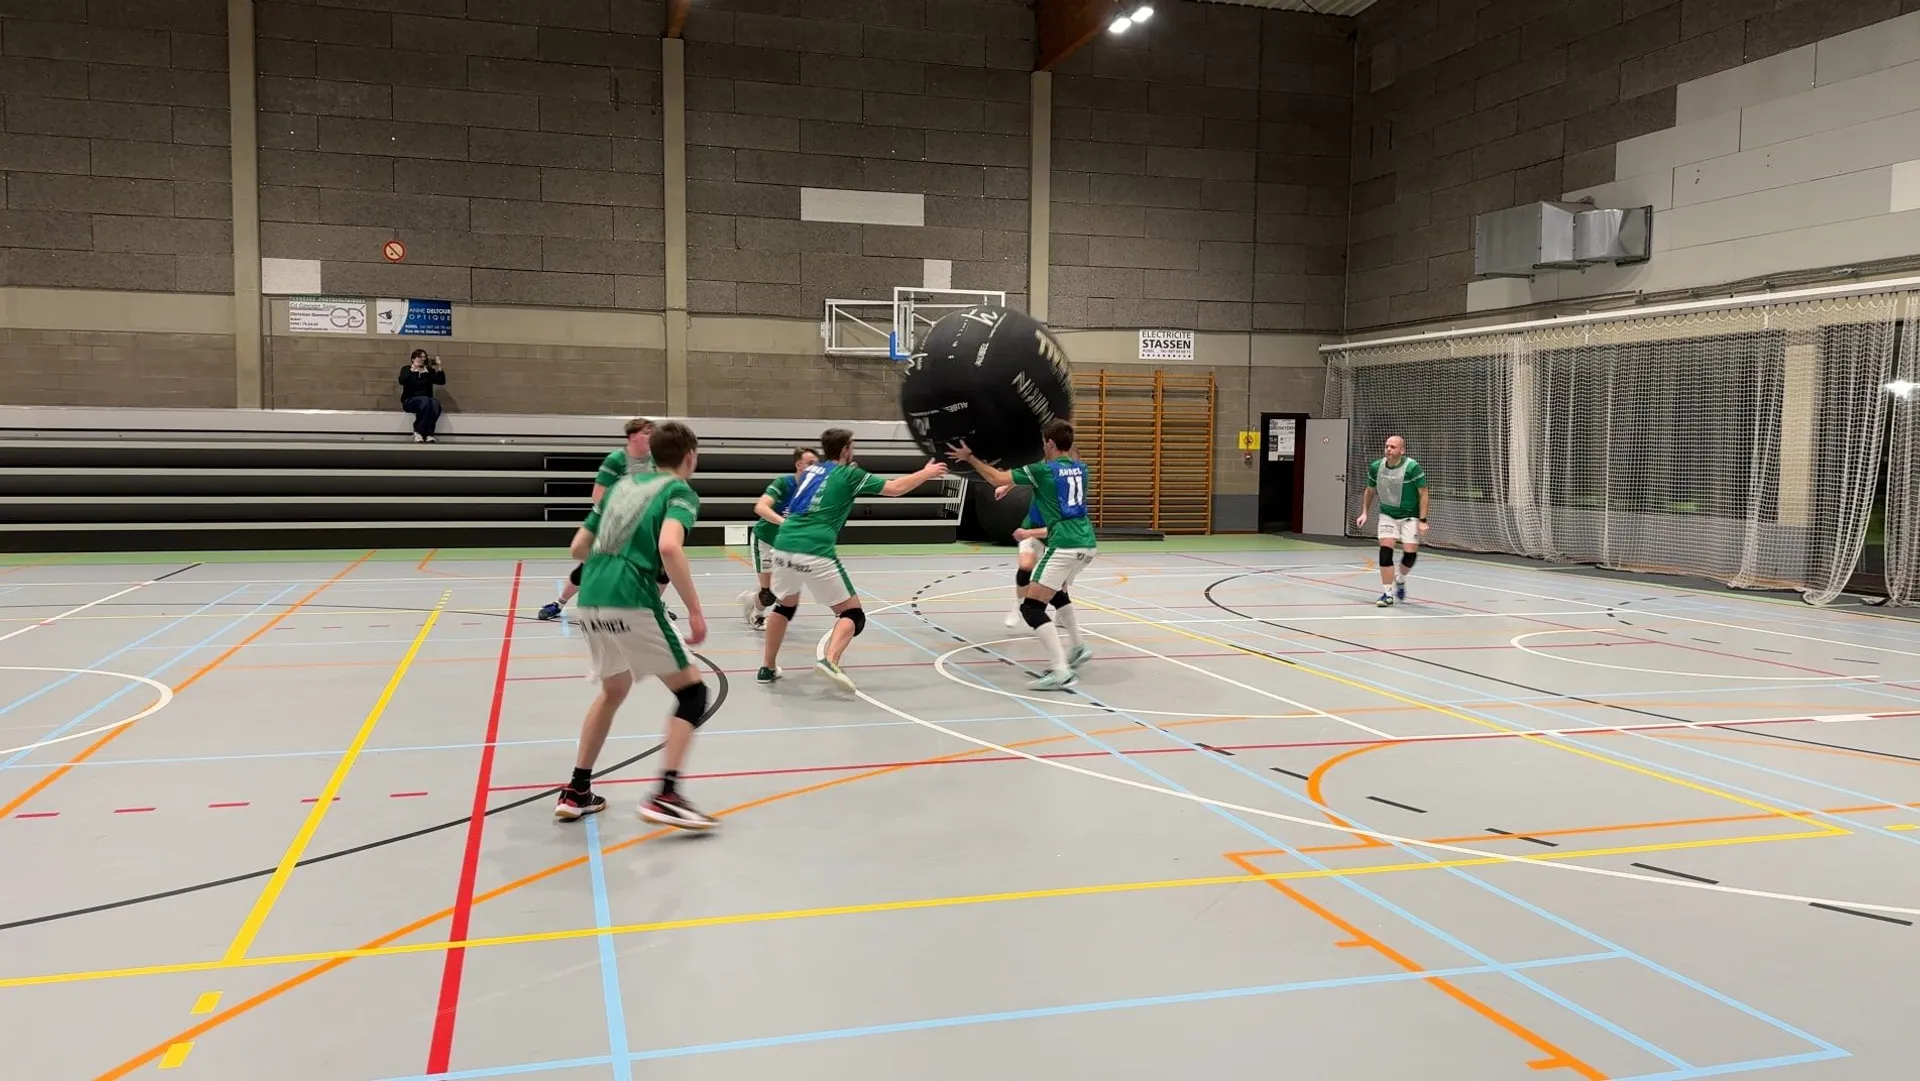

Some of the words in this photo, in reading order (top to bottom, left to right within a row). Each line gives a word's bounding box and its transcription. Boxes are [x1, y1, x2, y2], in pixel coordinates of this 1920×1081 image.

[1142, 330, 1192, 339] ELECTRICITE
[1142, 338, 1191, 349] STASSEN
[1066, 475, 1084, 507] 11
